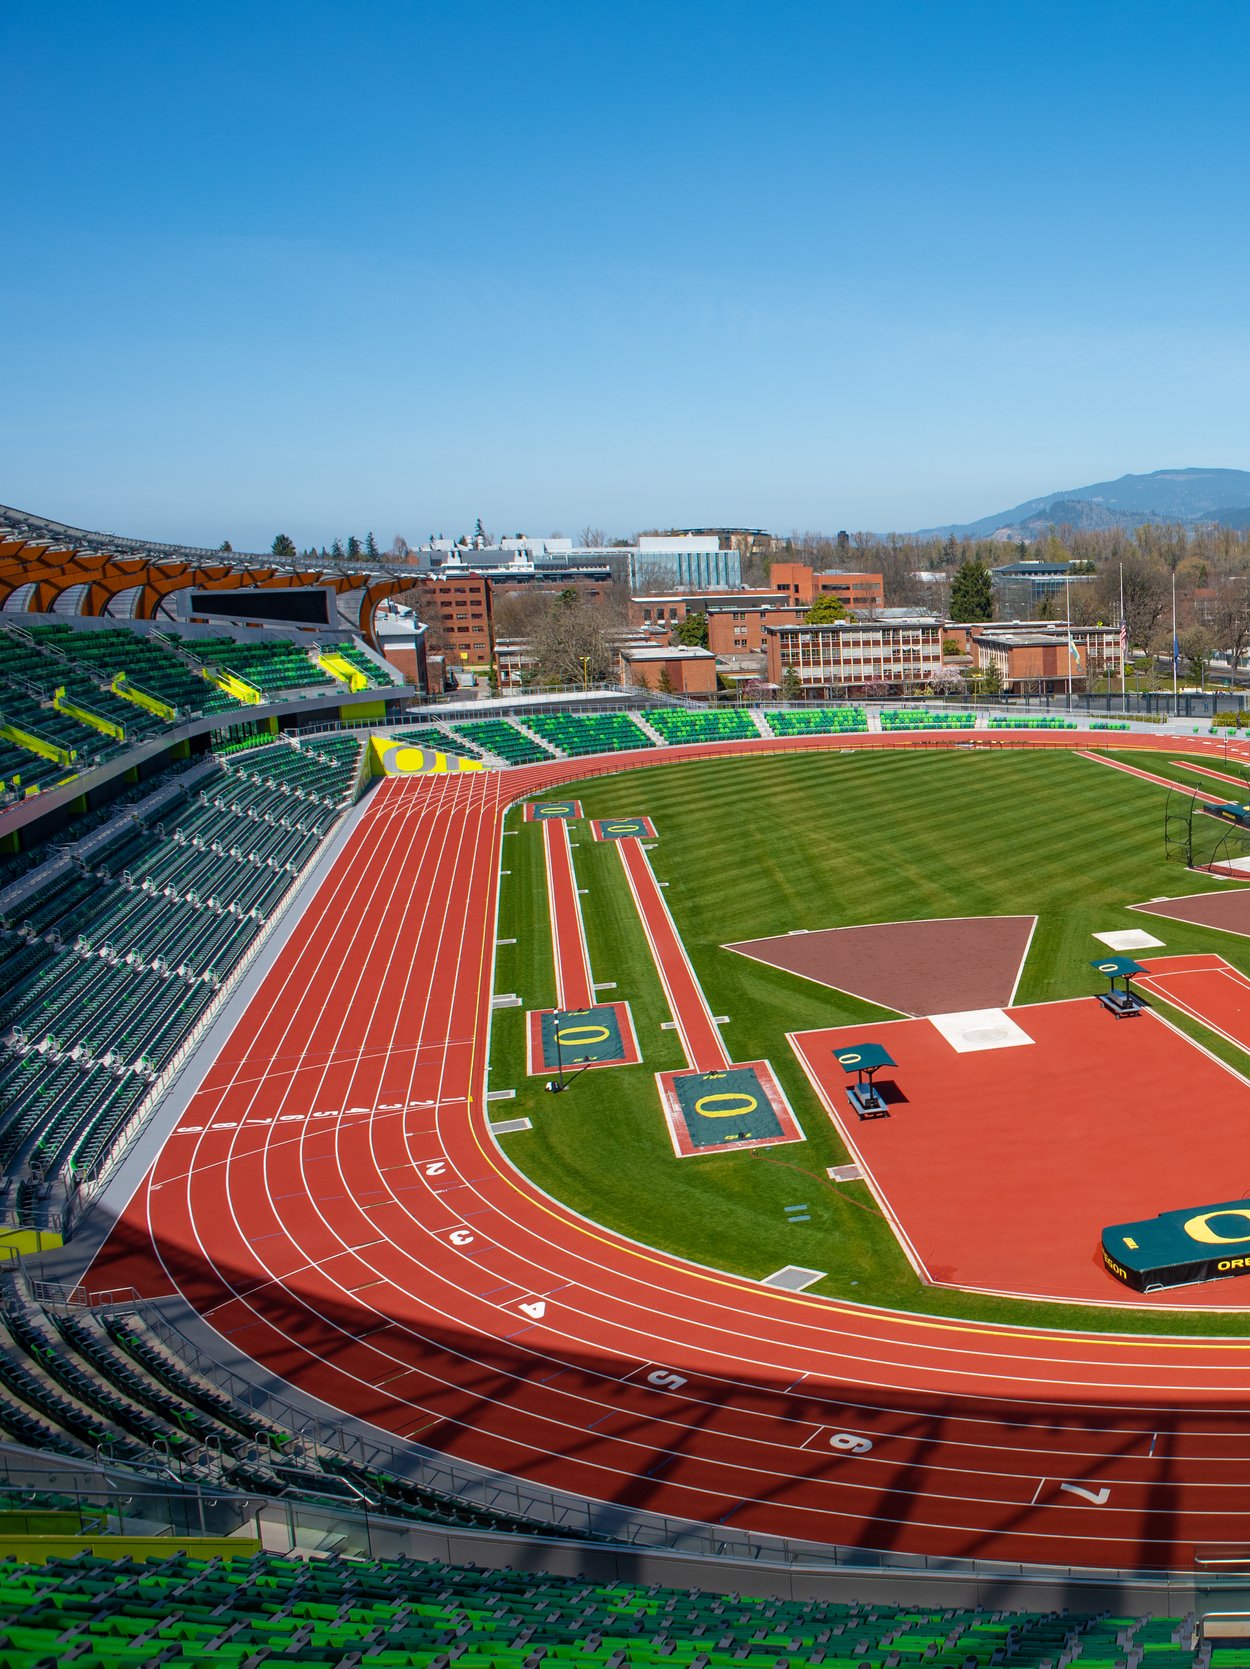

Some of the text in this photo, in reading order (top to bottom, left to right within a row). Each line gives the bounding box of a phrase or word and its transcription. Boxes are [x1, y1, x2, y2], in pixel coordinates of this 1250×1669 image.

[426, 1161, 446, 1176] 2
[449, 1230, 474, 1245] 3
[518, 1301, 546, 1318] 4
[647, 1370, 688, 1390] 5
[829, 1433, 873, 1453] 6
[1060, 1482, 1111, 1505] 7
